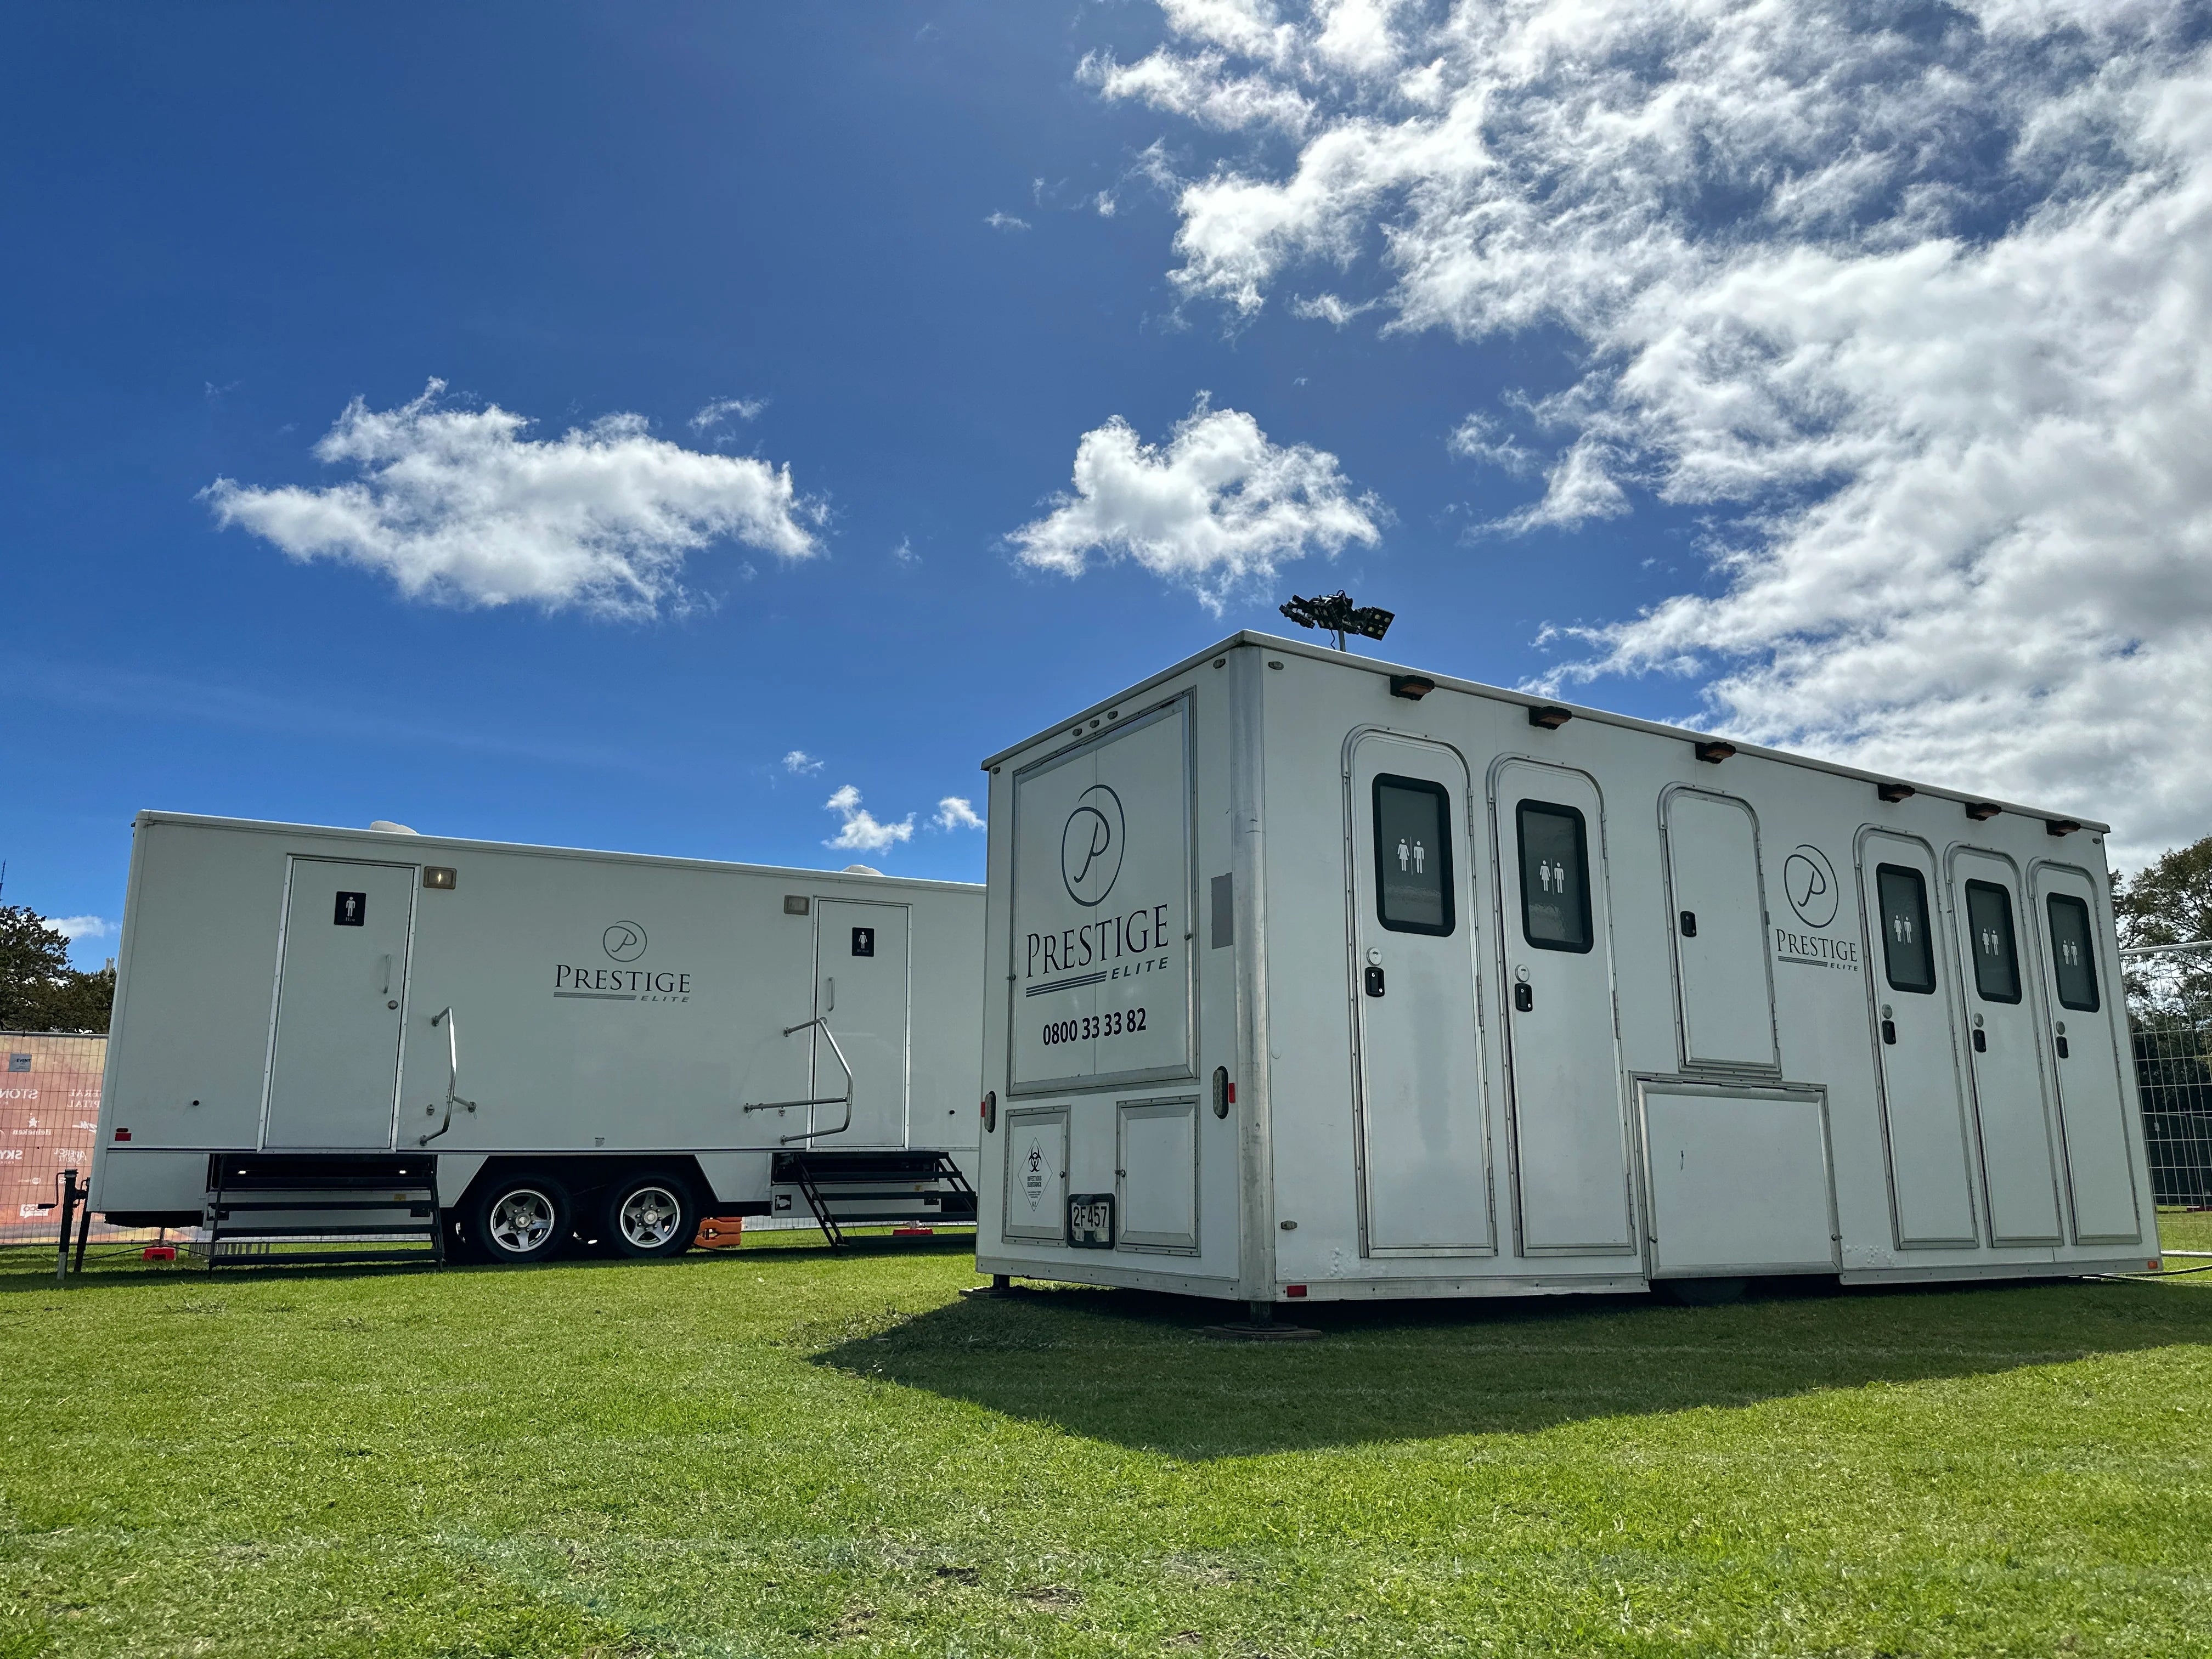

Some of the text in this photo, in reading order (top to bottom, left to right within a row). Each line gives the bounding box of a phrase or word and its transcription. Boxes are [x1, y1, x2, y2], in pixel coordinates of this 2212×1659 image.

[1026, 904, 1169, 978] PRESTIGE
[1775, 929, 1857, 962] PRESTIGE
[554, 964, 691, 994] PRESTIGE
[1111, 956, 1169, 980] ELITE
[1830, 963, 1859, 972] ELITE
[1043, 1007, 1147, 1046] 0800 33 33 82
